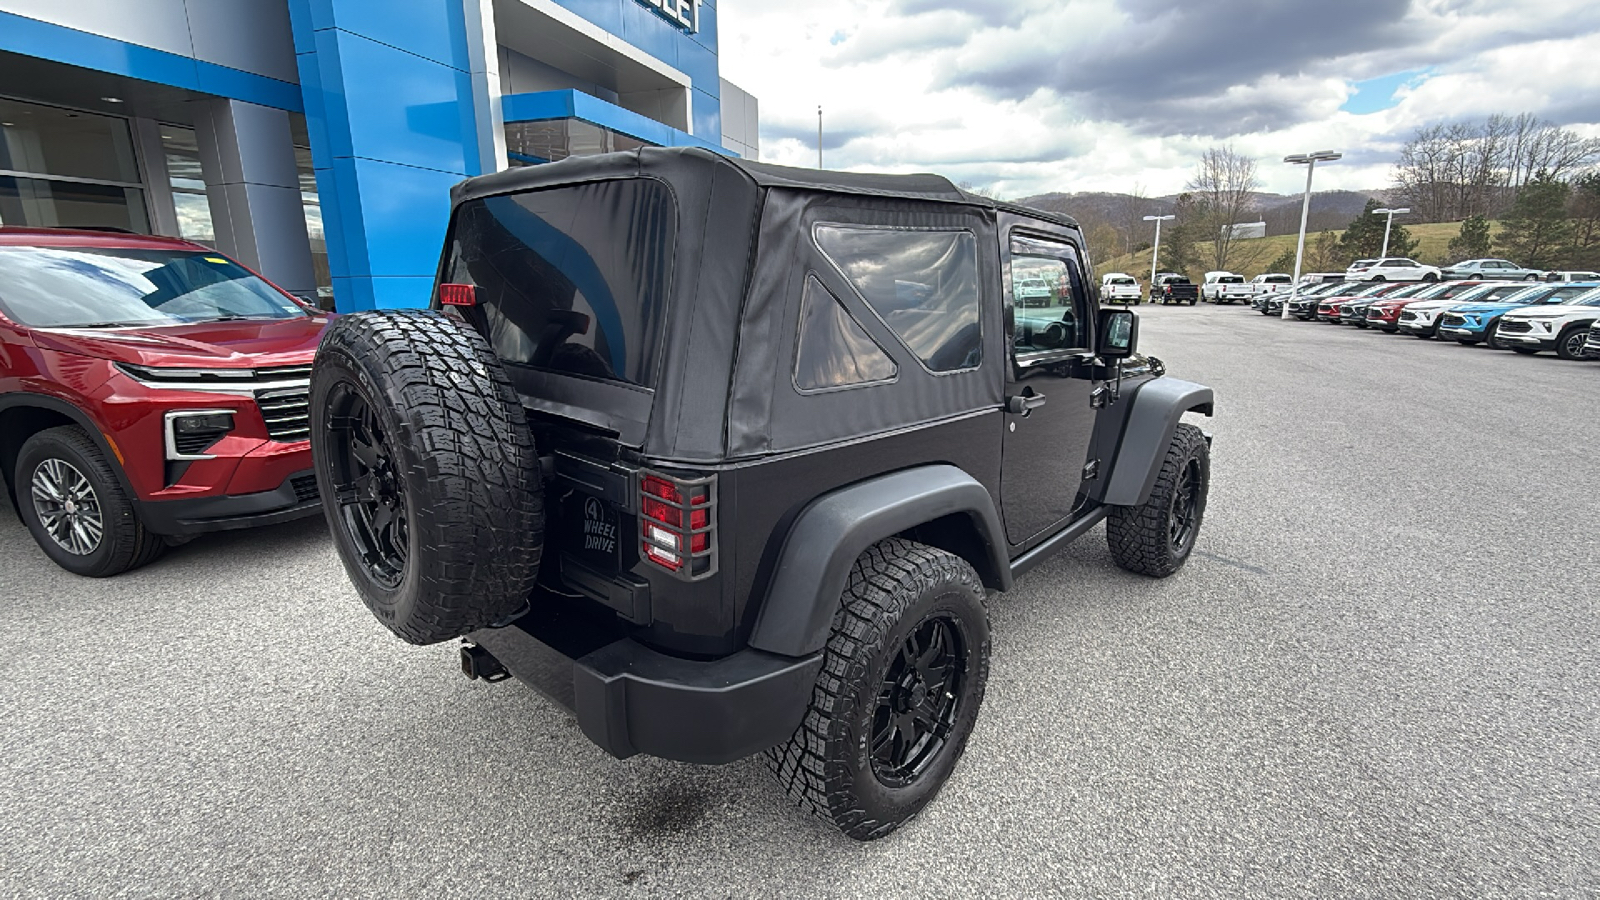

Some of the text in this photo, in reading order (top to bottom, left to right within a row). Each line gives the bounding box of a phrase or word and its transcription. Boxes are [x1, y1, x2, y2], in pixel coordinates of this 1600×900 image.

[588, 501, 597, 520] 4
[584, 520, 615, 539] WHEEL
[585, 535, 615, 553] DRIVE
